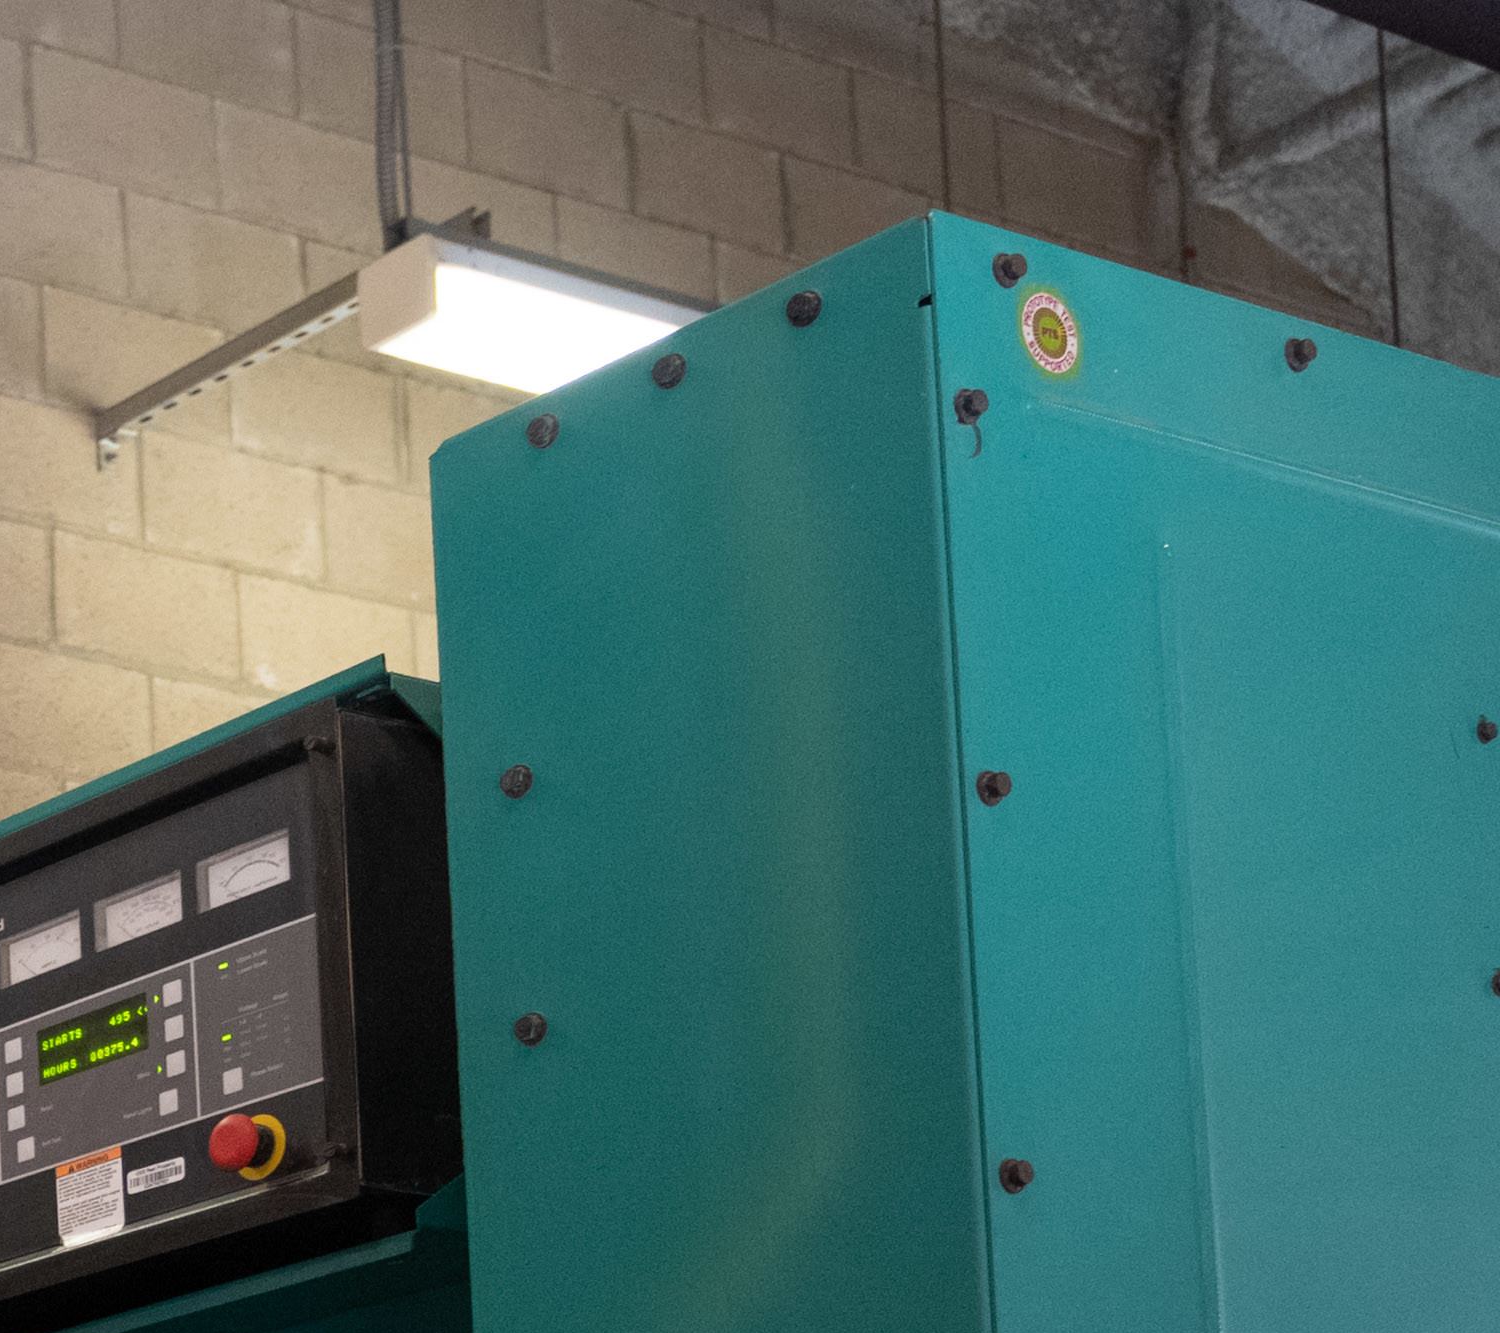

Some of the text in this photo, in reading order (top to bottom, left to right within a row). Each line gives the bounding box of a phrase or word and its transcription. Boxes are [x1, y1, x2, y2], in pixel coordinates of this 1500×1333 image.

[42, 1010, 131, 1051] STARTS 495
[43, 1037, 139, 1078] HOURS 00375.4
[76, 1154, 109, 1170] WARNING
